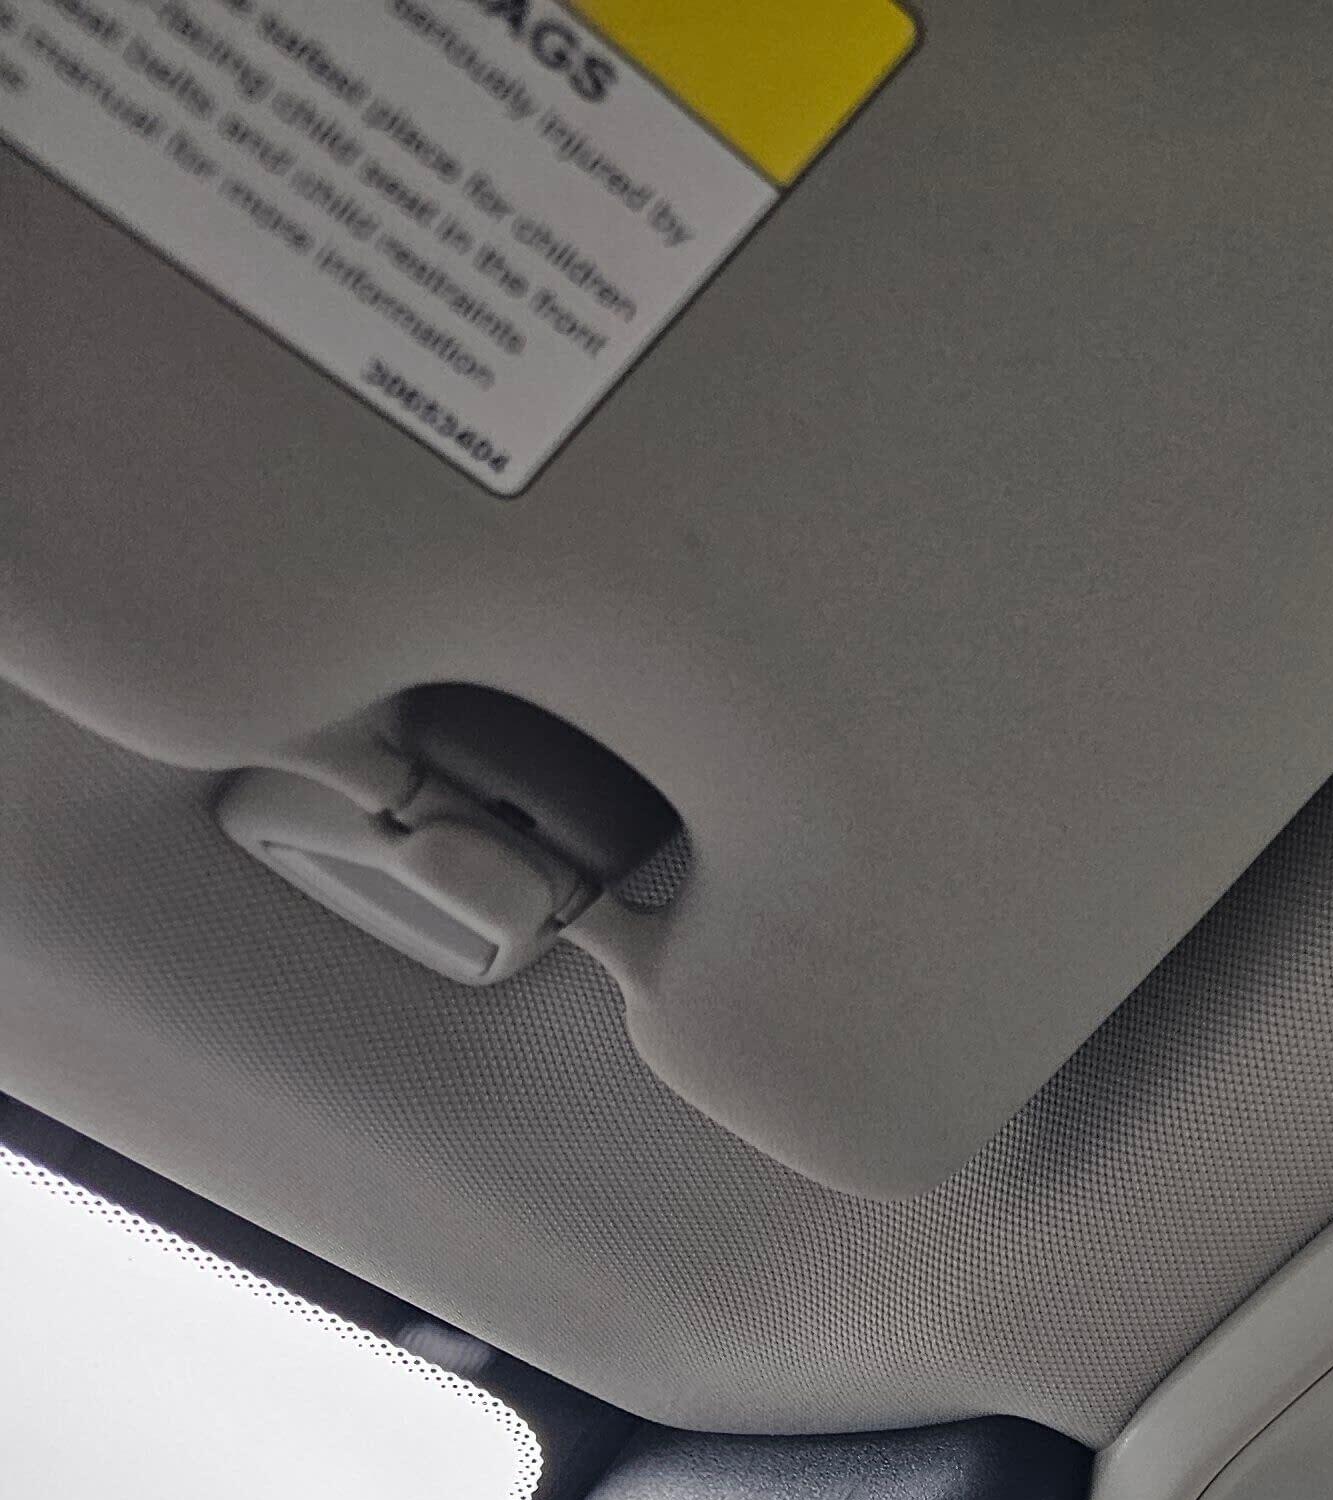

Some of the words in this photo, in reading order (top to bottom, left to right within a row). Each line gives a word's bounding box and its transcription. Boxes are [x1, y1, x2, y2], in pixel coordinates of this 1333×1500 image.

[435, 214, 476, 254] in
[472, 244, 529, 299] the
[528, 284, 609, 358] front
[459, 168, 515, 221] for
[510, 213, 637, 324] children
[644, 198, 694, 248] by
